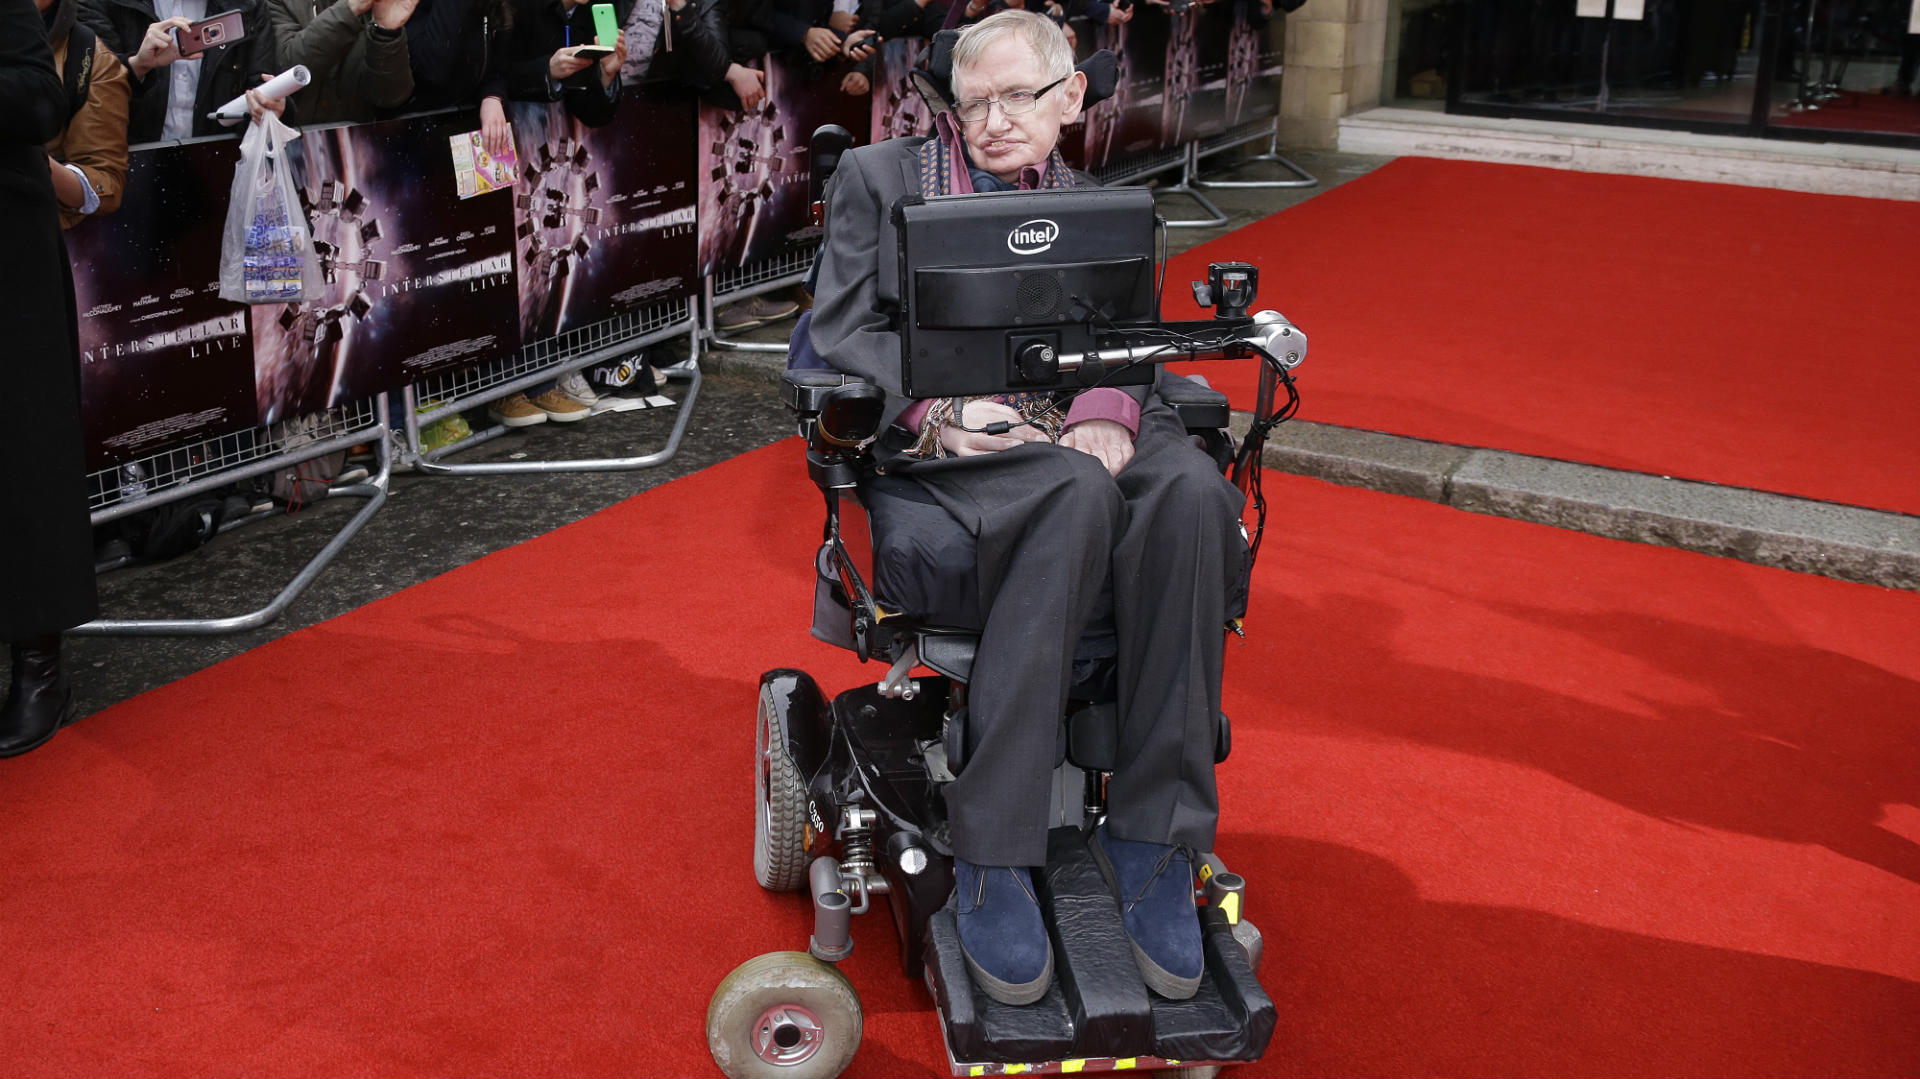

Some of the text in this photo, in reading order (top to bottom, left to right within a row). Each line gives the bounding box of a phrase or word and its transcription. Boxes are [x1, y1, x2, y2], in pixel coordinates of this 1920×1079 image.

[663, 223, 694, 239] LIVE
[1014, 226, 1050, 244] intel
[381, 257, 508, 297] INTERSTELLAR
[470, 273, 509, 293] LIVE
[84, 317, 240, 364] NTERSTELLAR
[191, 336, 241, 359] LIVE
[809, 800, 825, 832] C350
